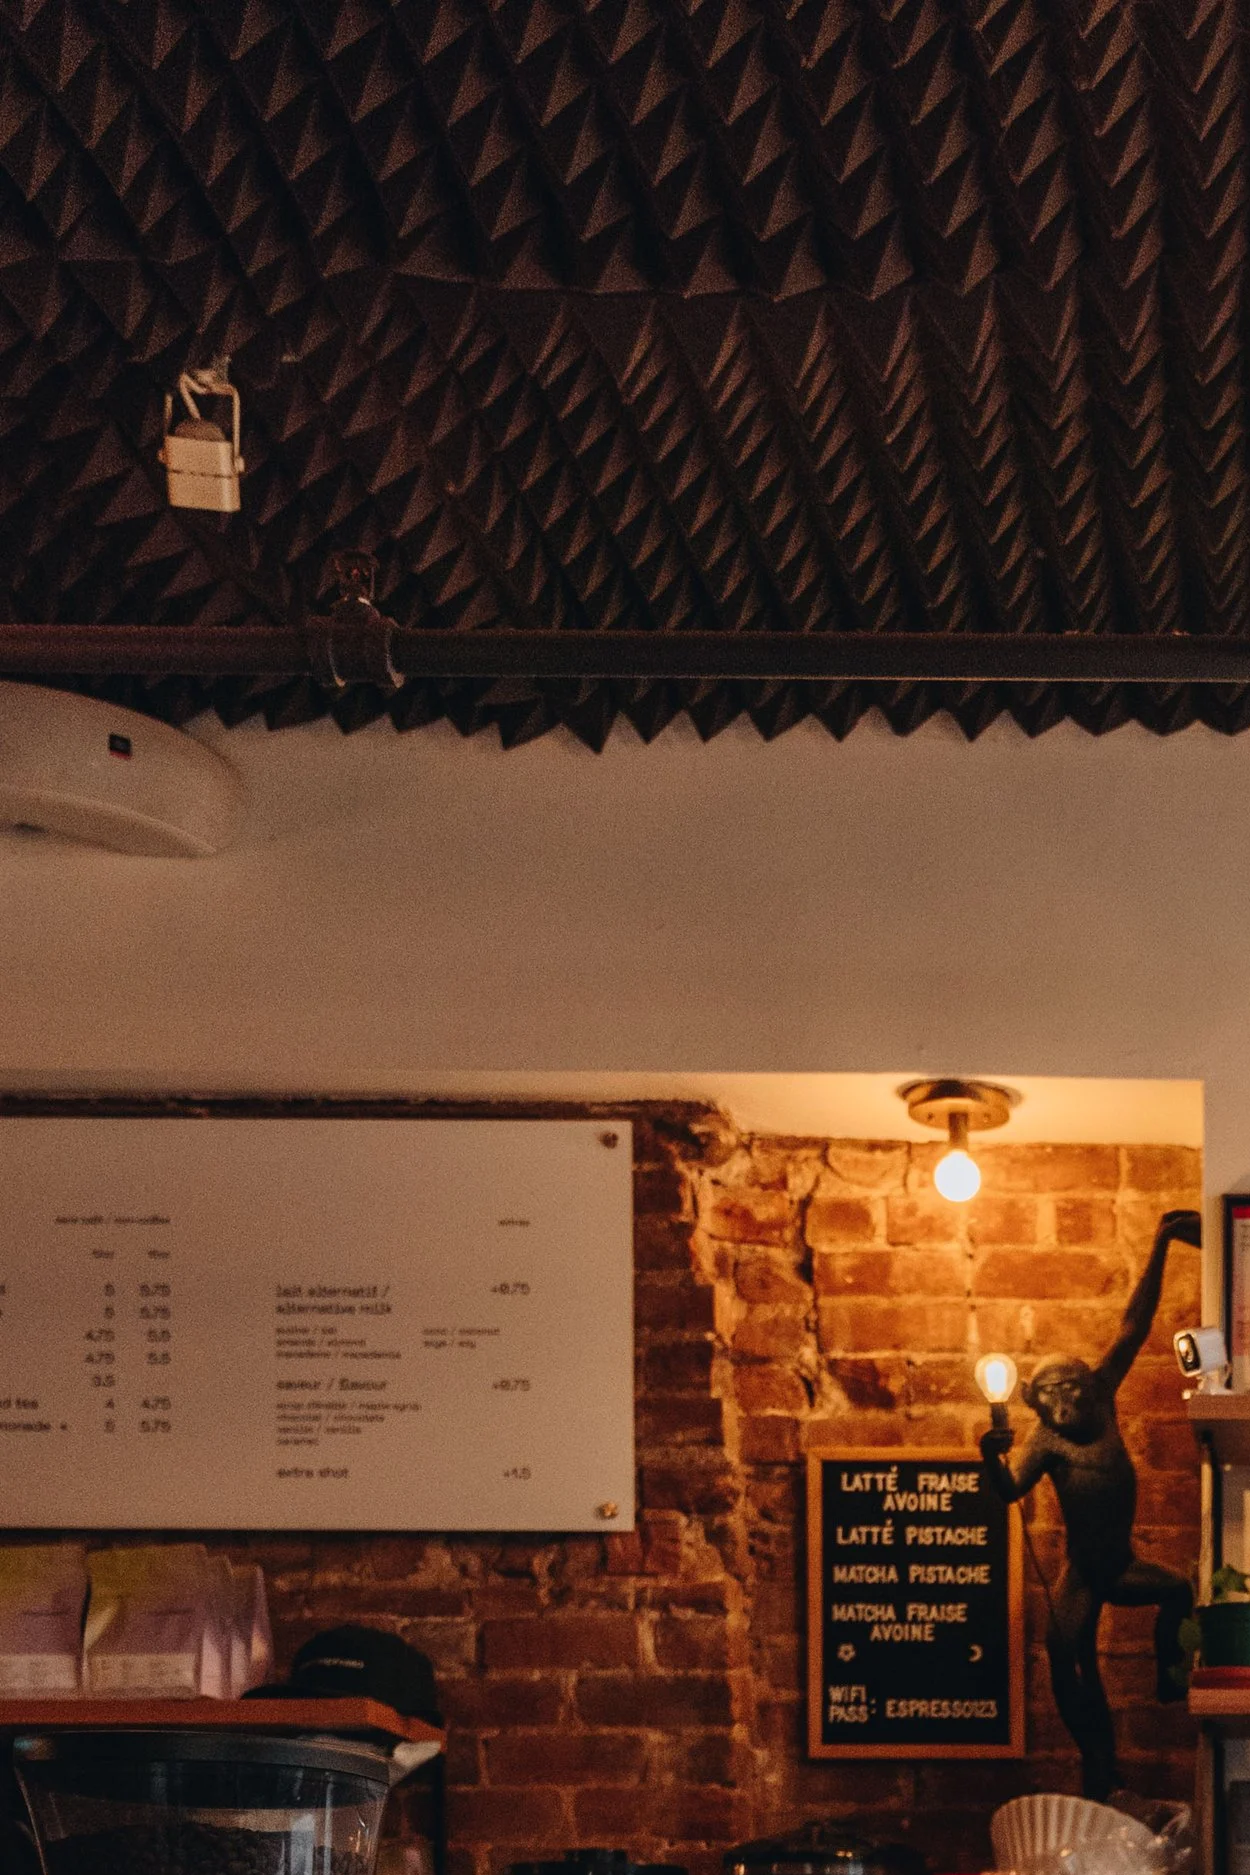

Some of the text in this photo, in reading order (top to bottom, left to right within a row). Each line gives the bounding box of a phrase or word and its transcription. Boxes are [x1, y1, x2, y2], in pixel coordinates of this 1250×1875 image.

[841, 1465, 980, 1492] LATTÉ FRAISE
[883, 1492, 952, 1512] AVOINE
[836, 1518, 988, 1545] LATTÉ PISTACHE
[833, 1564, 991, 1584] MATCHA PISTACHE
[832, 1602, 968, 1622] MATCHA FRAISE
[870, 1624, 935, 1642] AVOINE
[828, 1685, 866, 1703] WIFI
